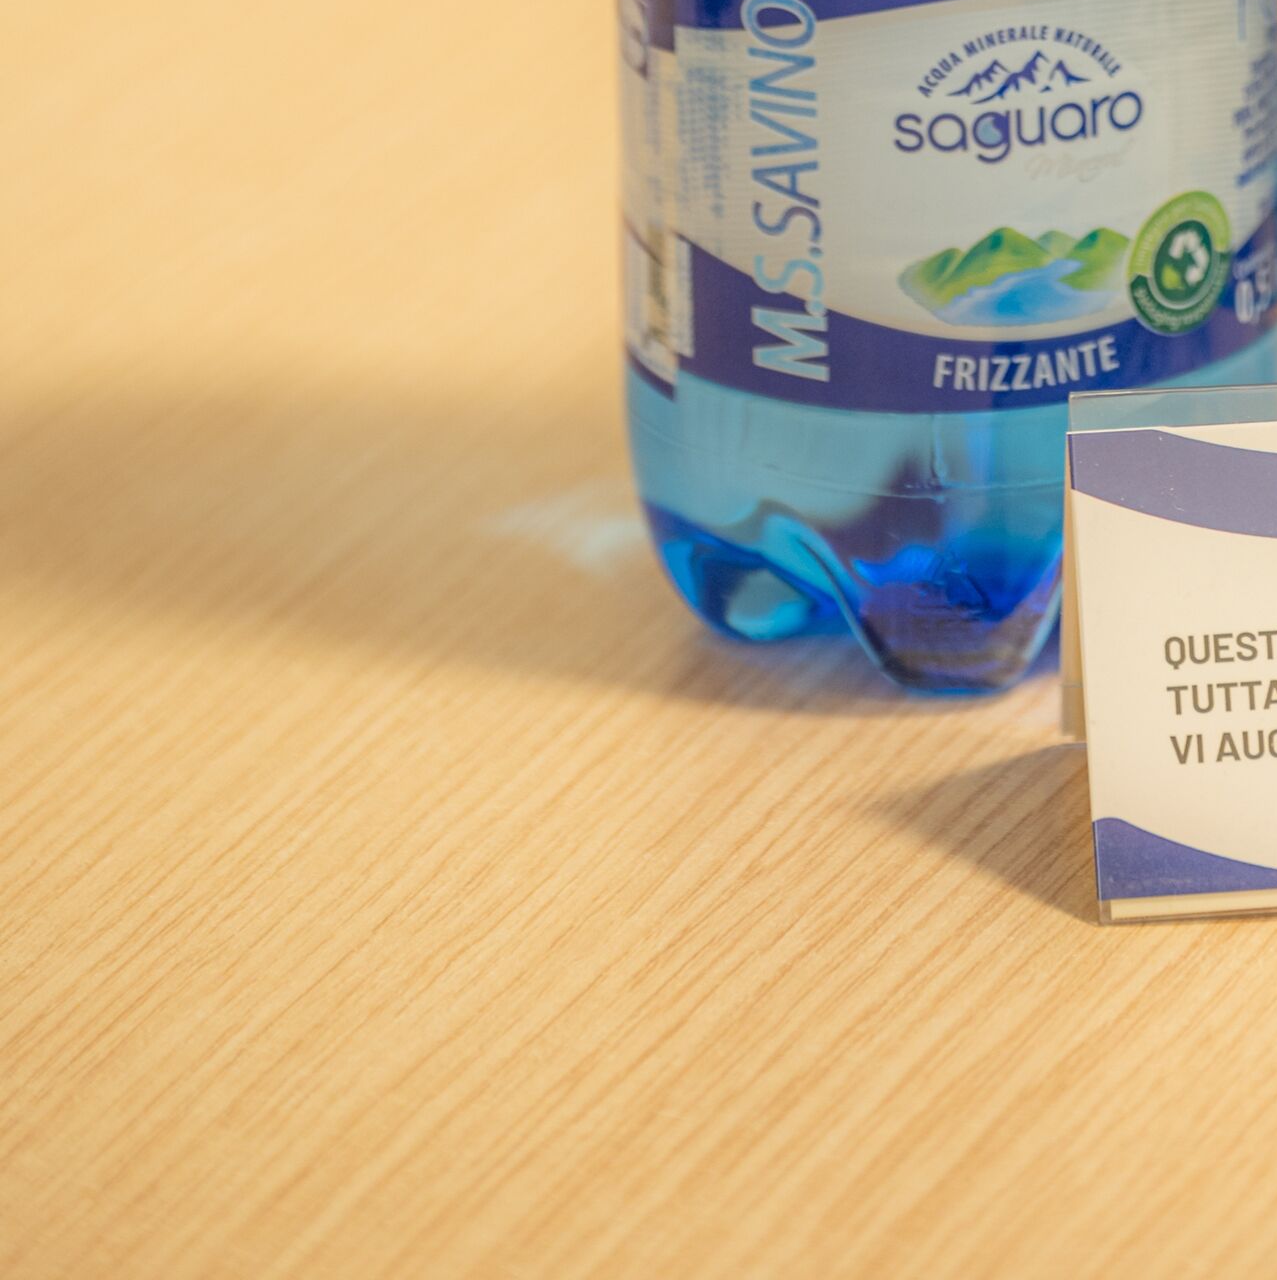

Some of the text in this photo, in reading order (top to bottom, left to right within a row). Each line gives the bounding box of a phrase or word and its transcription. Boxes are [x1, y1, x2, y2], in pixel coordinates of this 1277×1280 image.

[917, 25, 1122, 98] ACQUA MINERALE NATURALE
[894, 91, 1142, 164] saguaro
[932, 335, 1120, 391] FRIZZANTE
[1169, 733, 1205, 766] VI
